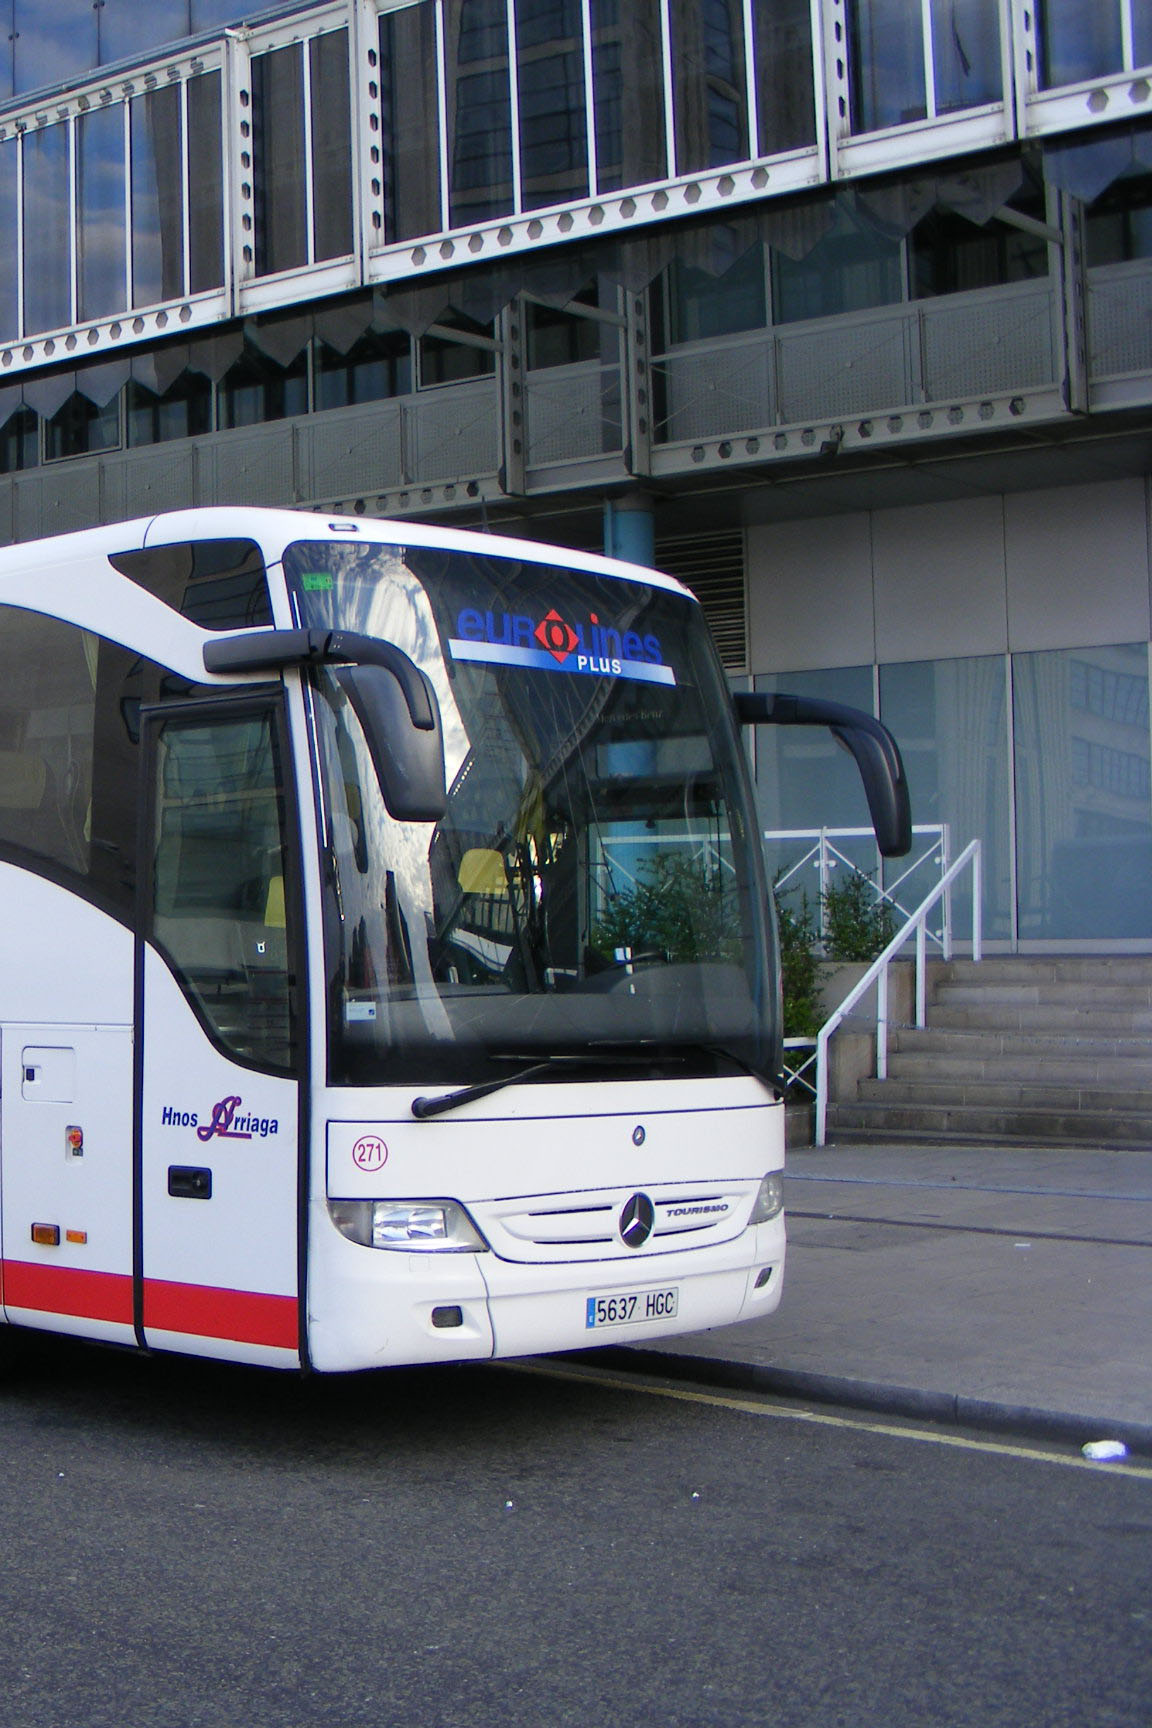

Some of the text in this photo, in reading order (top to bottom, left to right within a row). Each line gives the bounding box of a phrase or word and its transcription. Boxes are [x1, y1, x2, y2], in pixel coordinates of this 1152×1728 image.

[161, 1096, 278, 1141] Hnos Arriaga
[357, 1143, 382, 1162] 271
[666, 1204, 729, 1217] TOURISMO
[597, 1296, 638, 1323] 5637
[645, 1292, 674, 1317] HGC
